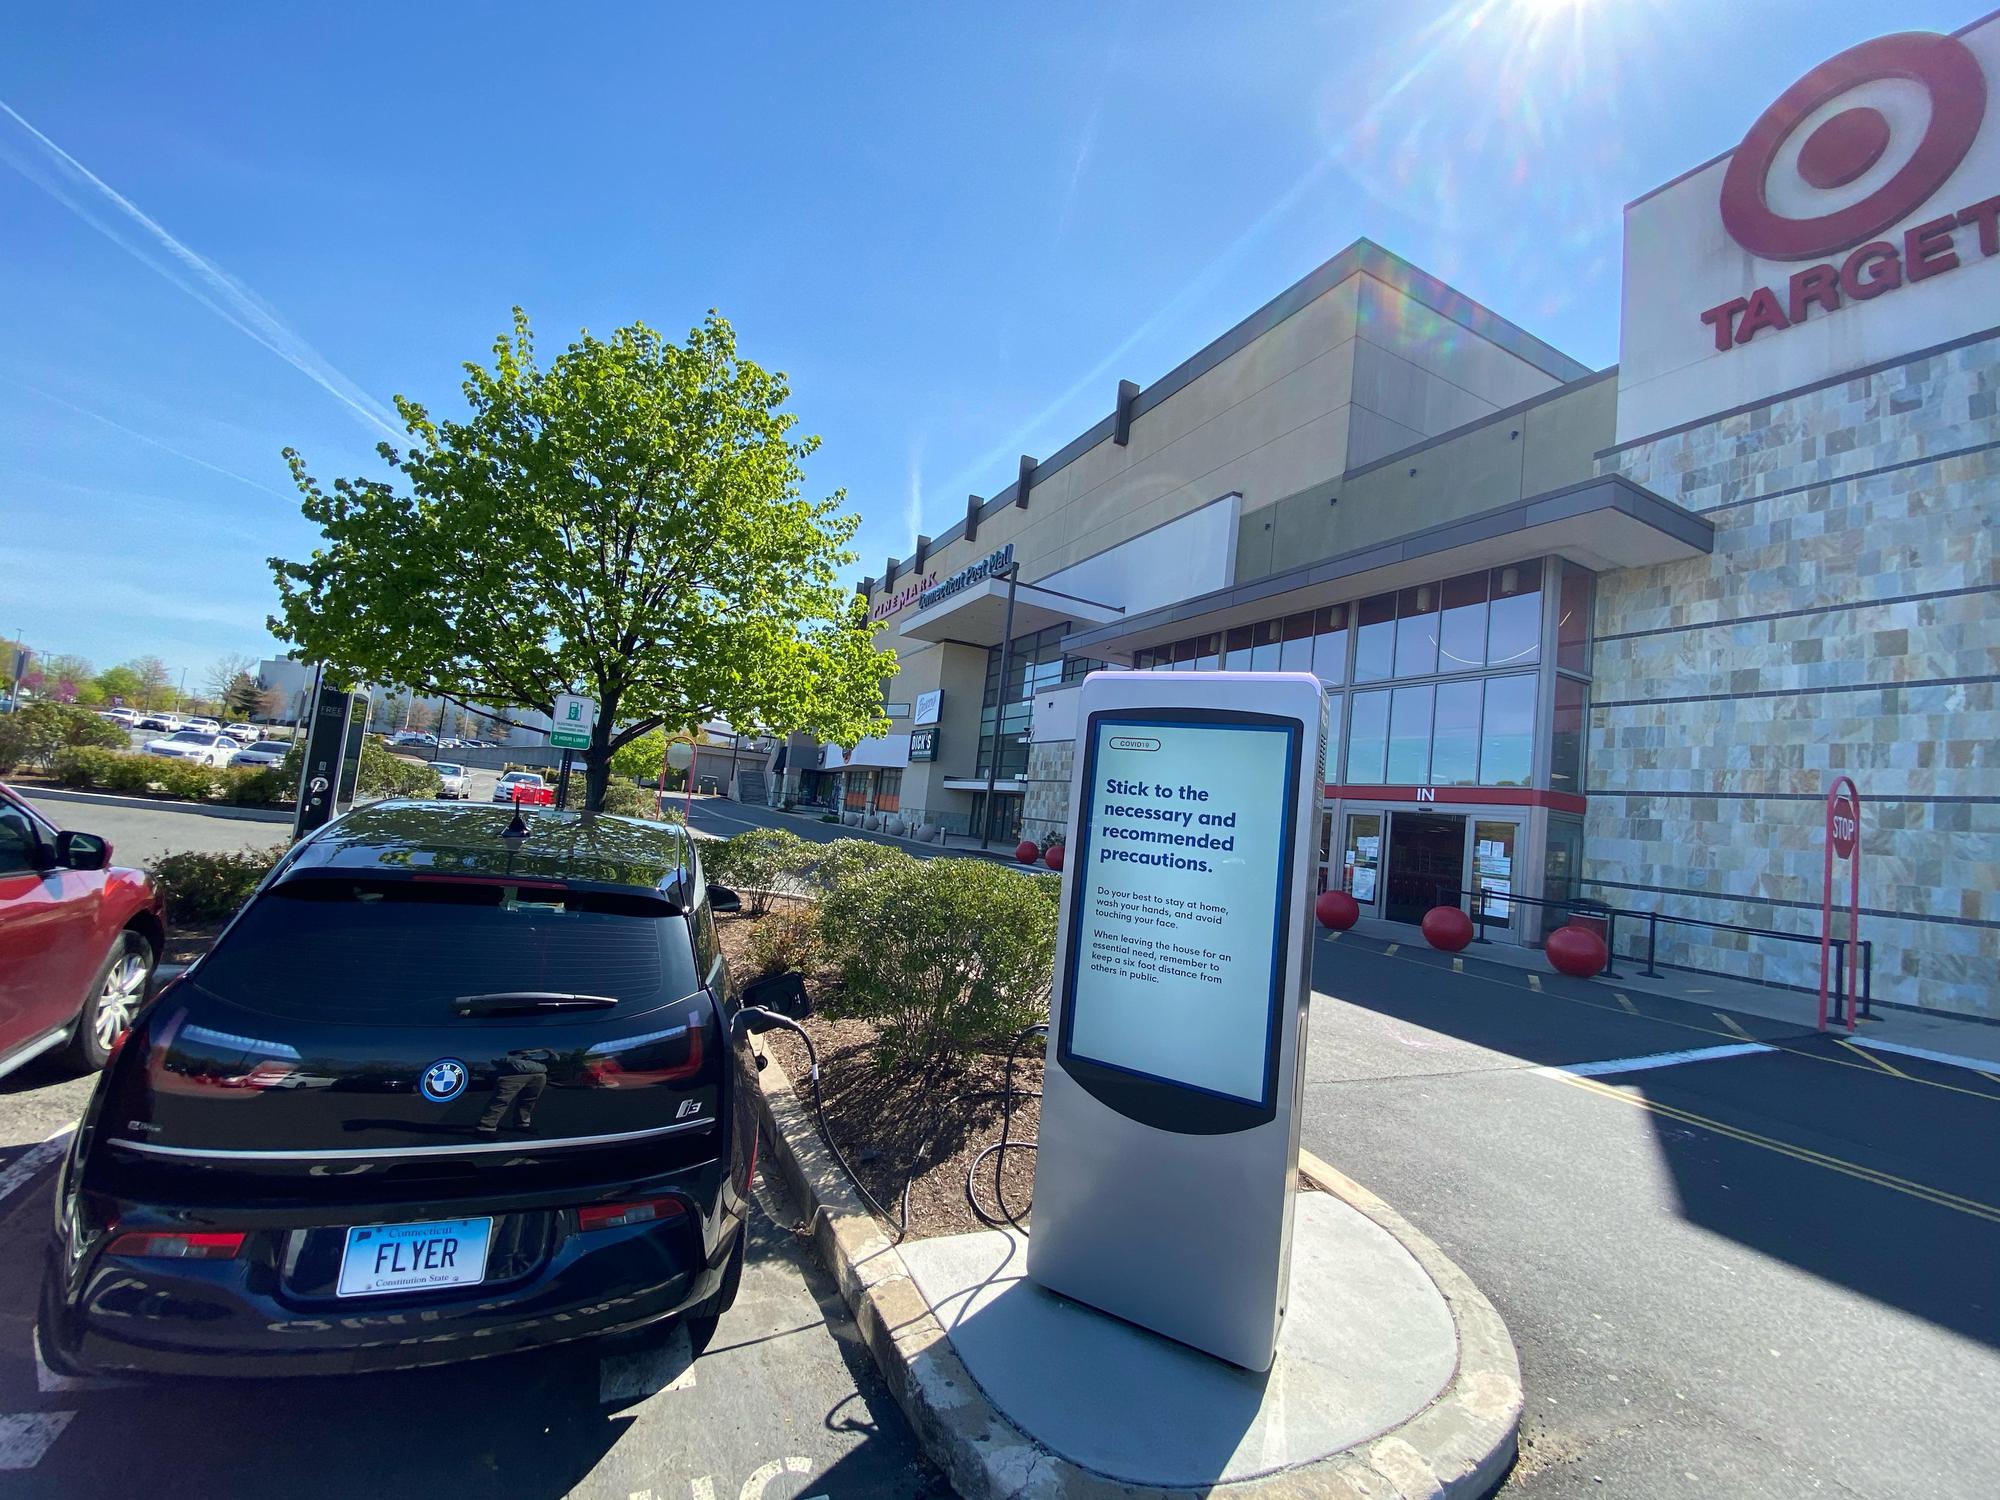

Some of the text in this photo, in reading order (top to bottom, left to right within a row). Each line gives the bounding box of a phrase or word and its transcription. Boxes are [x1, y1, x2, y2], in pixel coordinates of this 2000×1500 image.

[1701, 195, 2000, 351] TARGET
[966, 560, 988, 585] Post
[988, 543, 1014, 573] Mall
[912, 734, 932, 750] DICK'S
[1120, 740, 1150, 748] COVID19
[1106, 779, 1208, 801] Stick to the
[1416, 788, 1434, 801] IN
[1104, 804, 1236, 828] necessary and
[1832, 816, 1854, 840] STOP
[1102, 826, 1234, 852] recommended
[1100, 848, 1213, 873] precautions.
[1096, 898, 1222, 925] wash your hands, and avoid
[1098, 886, 1229, 916] Do your best to stay at home,
[1096, 908, 1178, 929] touching your face.
[1092, 942, 1220, 972] essential need, remember to
[1094, 929, 1232, 962] When leaving the house for an
[1090, 963, 1116, 974] others
[1130, 972, 1159, 983] public.
[1092, 952, 1112, 964] keep
[1123, 958, 1135, 967] six
[1138, 960, 1156, 970] foot
[1158, 964, 1197, 979] distance
[1200, 972, 1222, 984] from
[430, 1064, 462, 1076] BMW
[389, 1227, 452, 1238] Connecticut
[374, 1238, 458, 1274] FLYER
[376, 1274, 449, 1288] Constitution State
